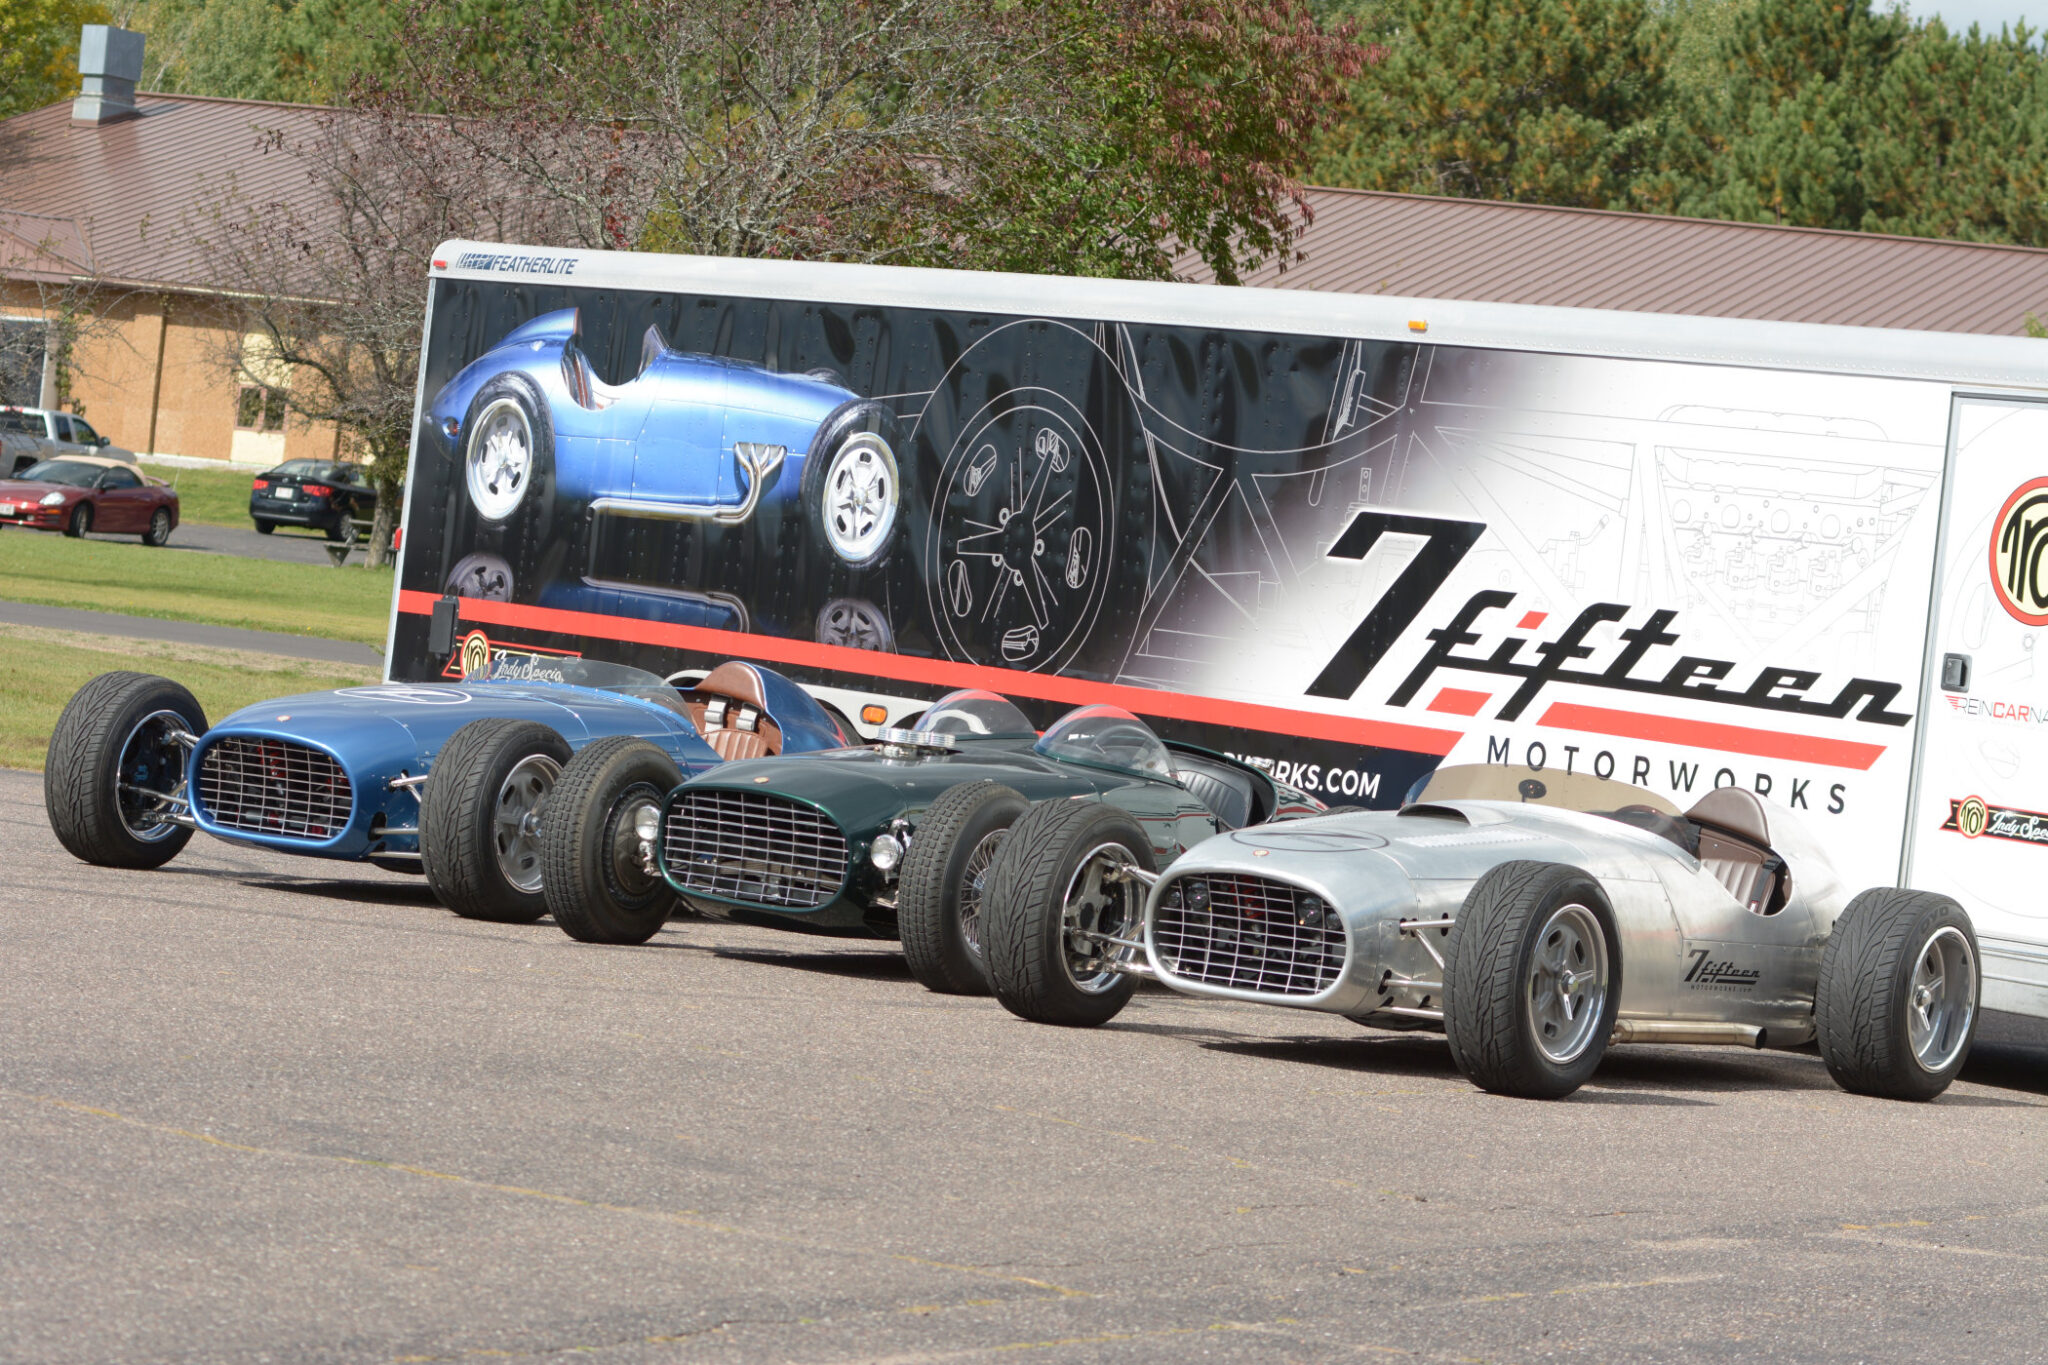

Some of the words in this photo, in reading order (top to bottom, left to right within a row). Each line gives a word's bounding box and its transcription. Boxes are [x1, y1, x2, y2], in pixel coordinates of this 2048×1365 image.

[491, 254, 579, 275] FEATHERLITE
[1486, 735, 1846, 814] MOTORWORKS
[1988, 811, 2020, 837] Indy
